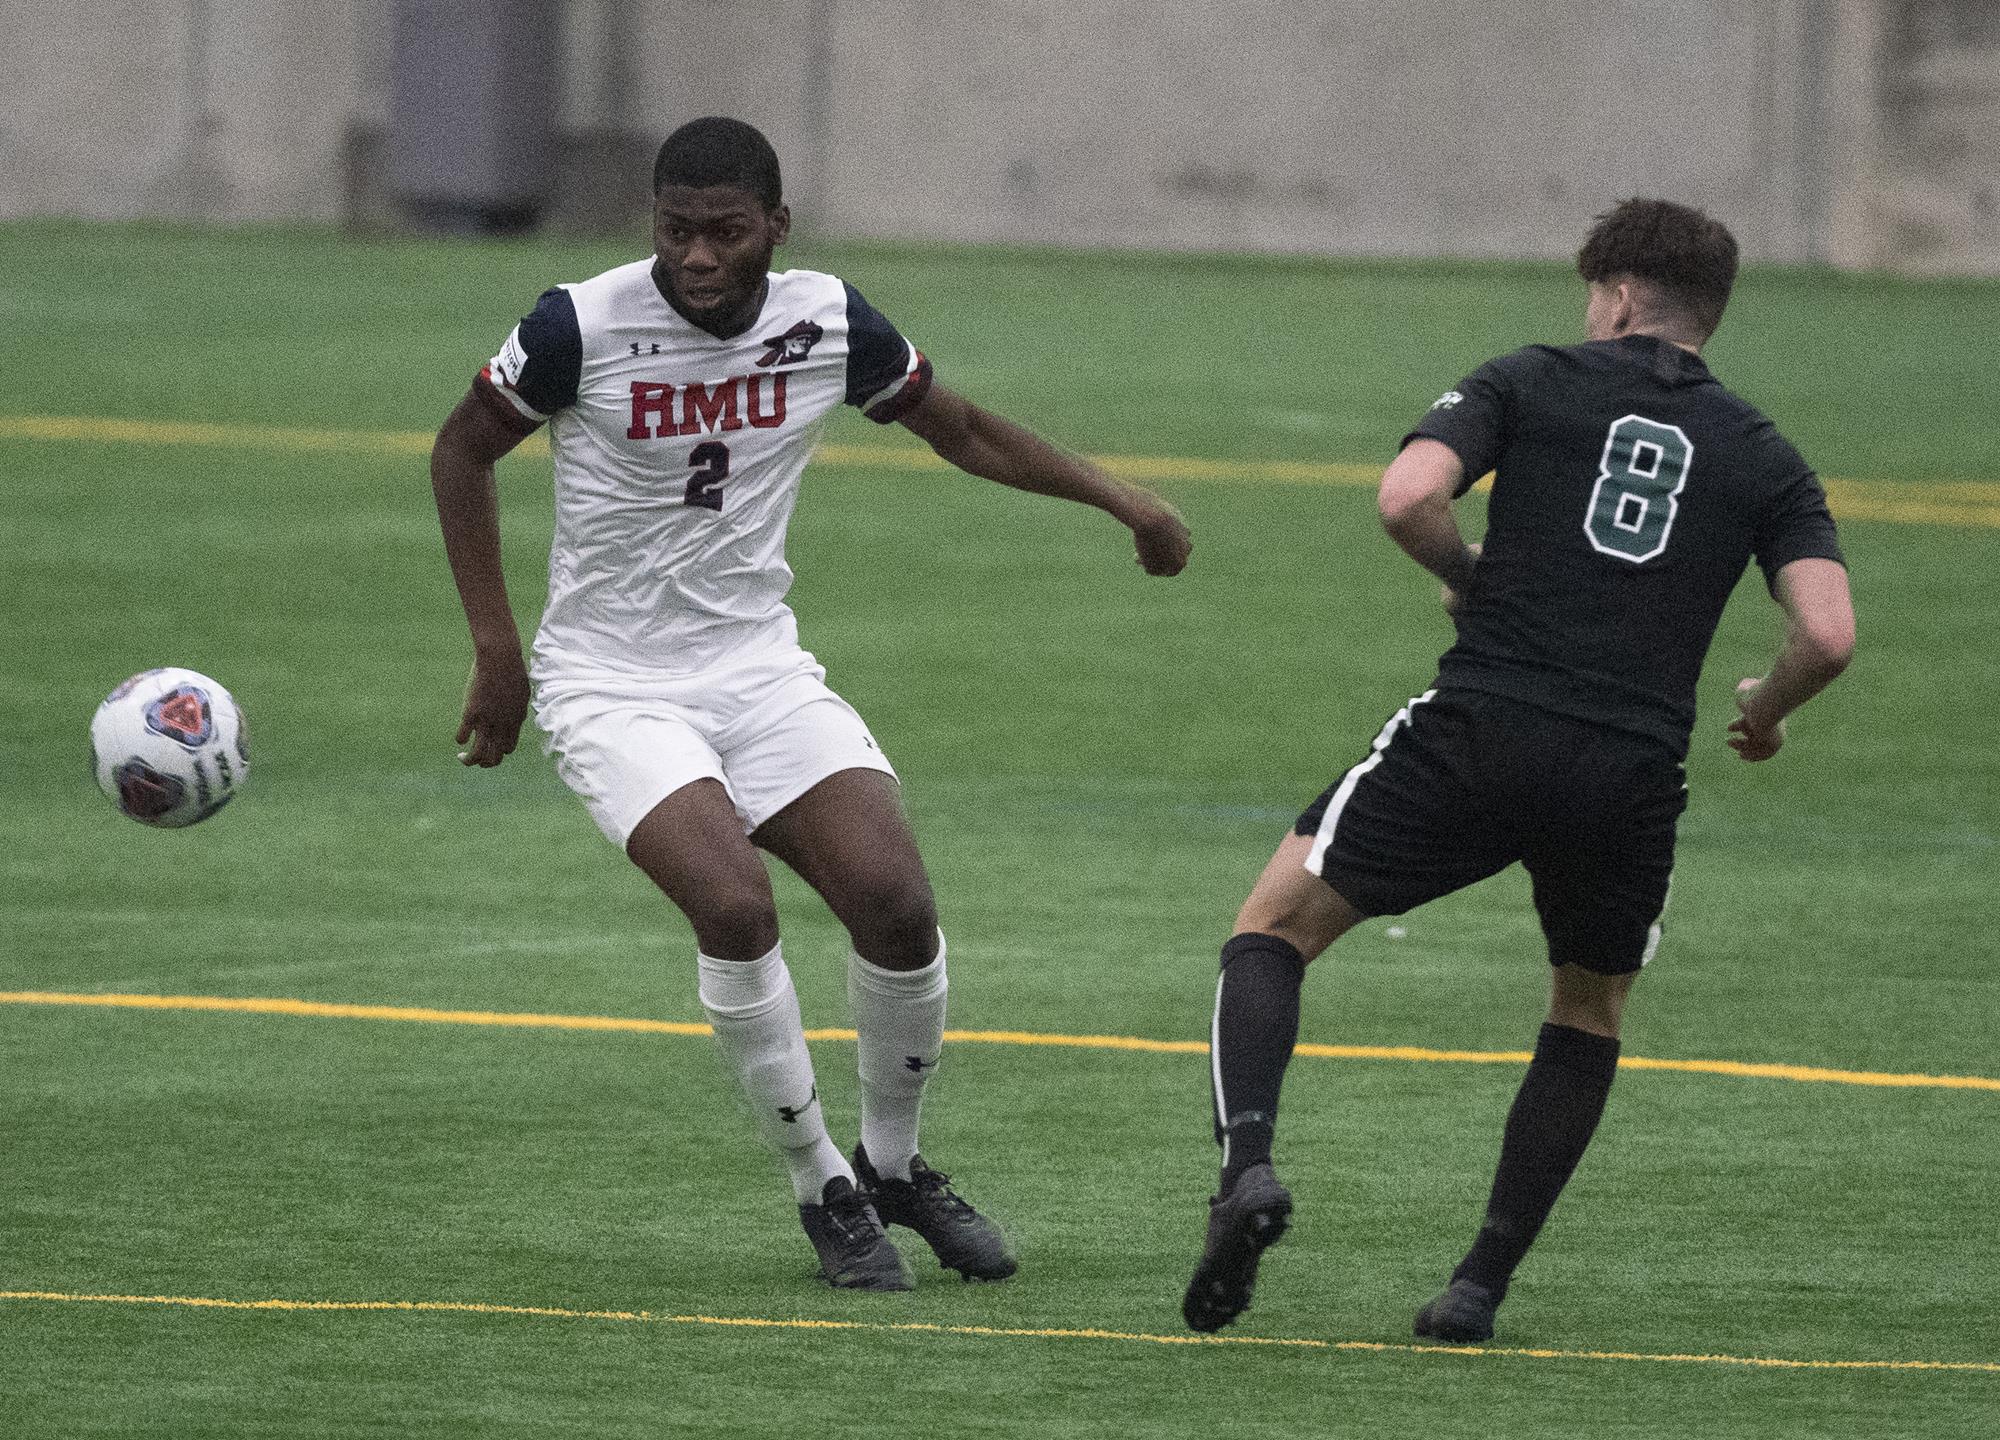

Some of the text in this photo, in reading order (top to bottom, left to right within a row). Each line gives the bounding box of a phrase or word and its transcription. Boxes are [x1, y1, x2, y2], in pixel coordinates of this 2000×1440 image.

[627, 371, 792, 440] RMU
[684, 440, 731, 512] 2
[1584, 414, 1694, 564] 8
